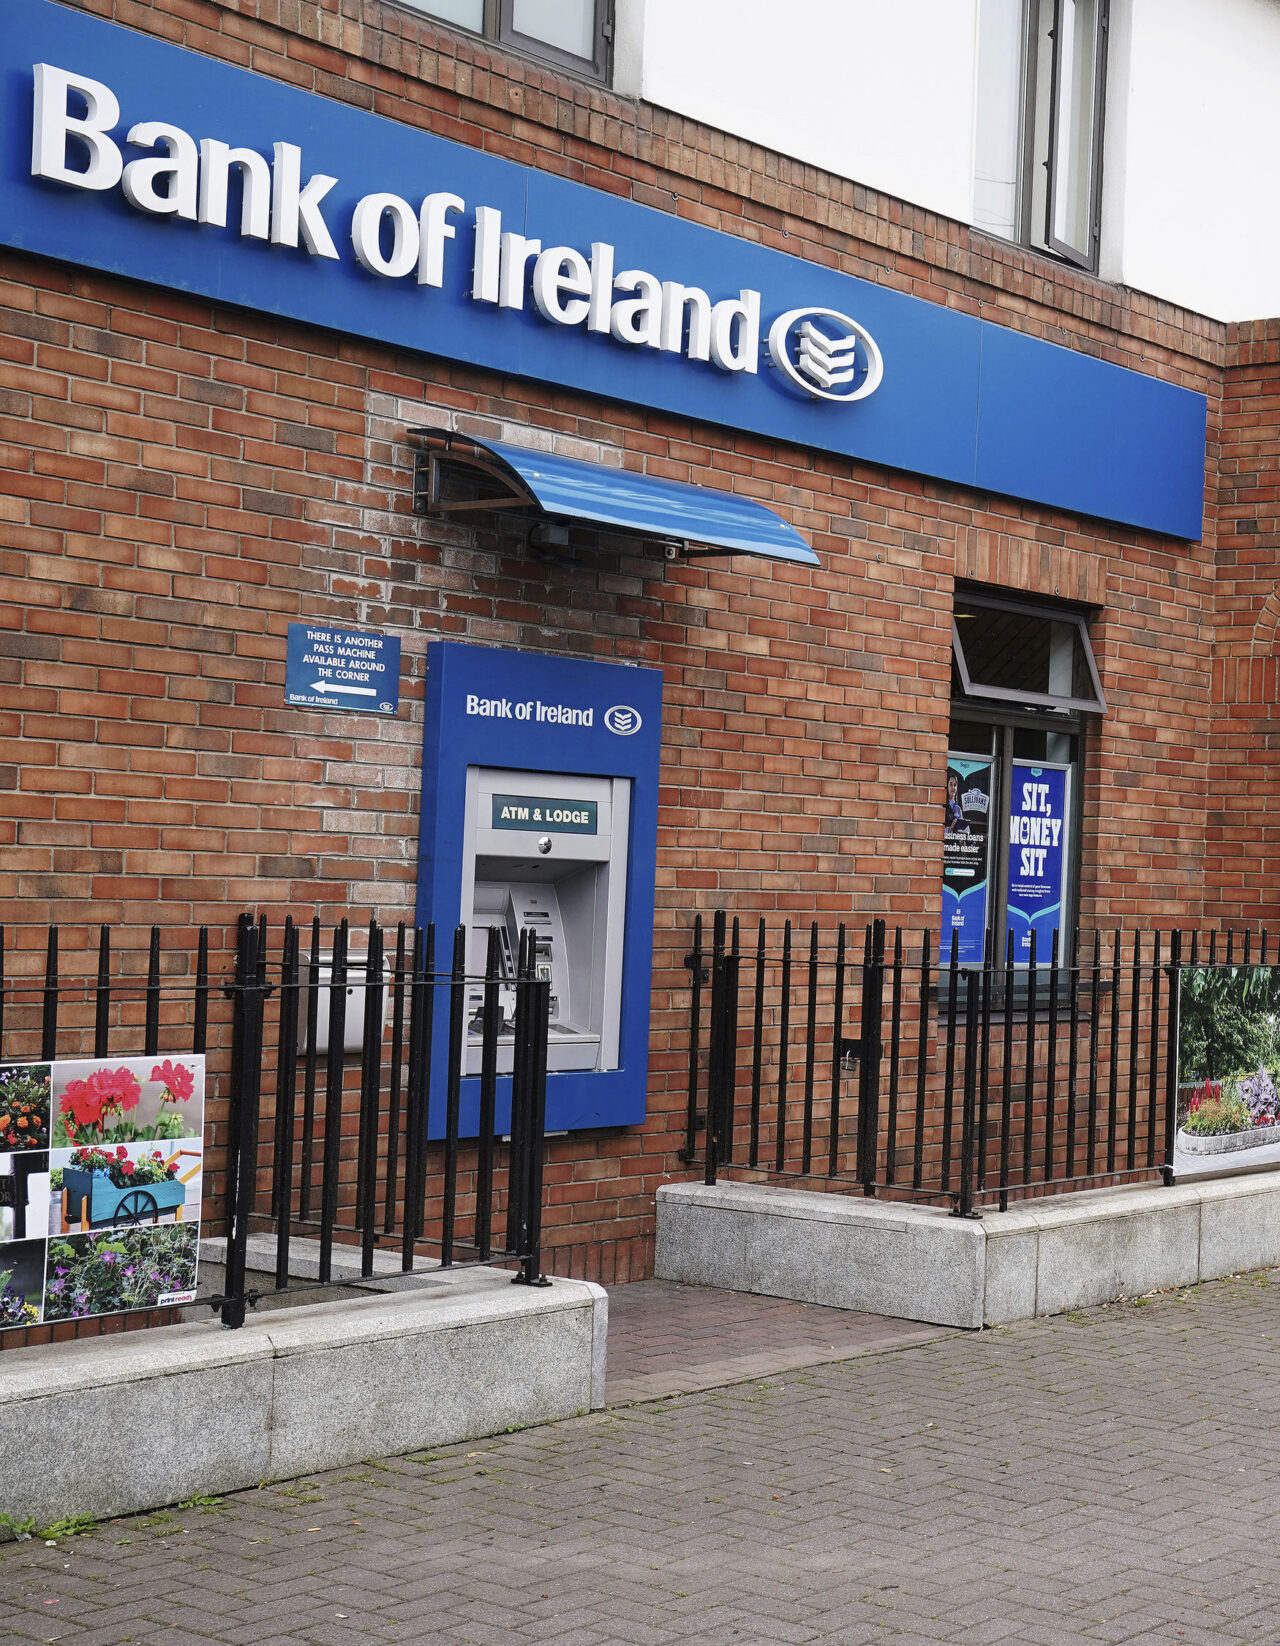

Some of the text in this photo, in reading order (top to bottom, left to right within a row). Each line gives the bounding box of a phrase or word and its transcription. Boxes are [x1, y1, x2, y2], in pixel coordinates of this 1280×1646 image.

[32, 63, 762, 375] Bank of Ireland
[307, 631, 383, 649] THERE IS ANOTHER
[313, 643, 376, 659] PASS MACHINE
[303, 654, 385, 672] AVAILABLE AROUND
[318, 668, 369, 682] THE CORNER
[290, 694, 308, 702] Bank
[316, 696, 338, 704] Ireland
[466, 694, 594, 727] Bank of Ireland
[1021, 782, 1052, 817] SIT,
[501, 806, 589, 824] ATM & LODGE
[944, 832, 984, 842] usiness loans
[1010, 816, 1062, 847] MONEY
[944, 842, 979, 854] made easier
[1020, 847, 1047, 877] SIT
